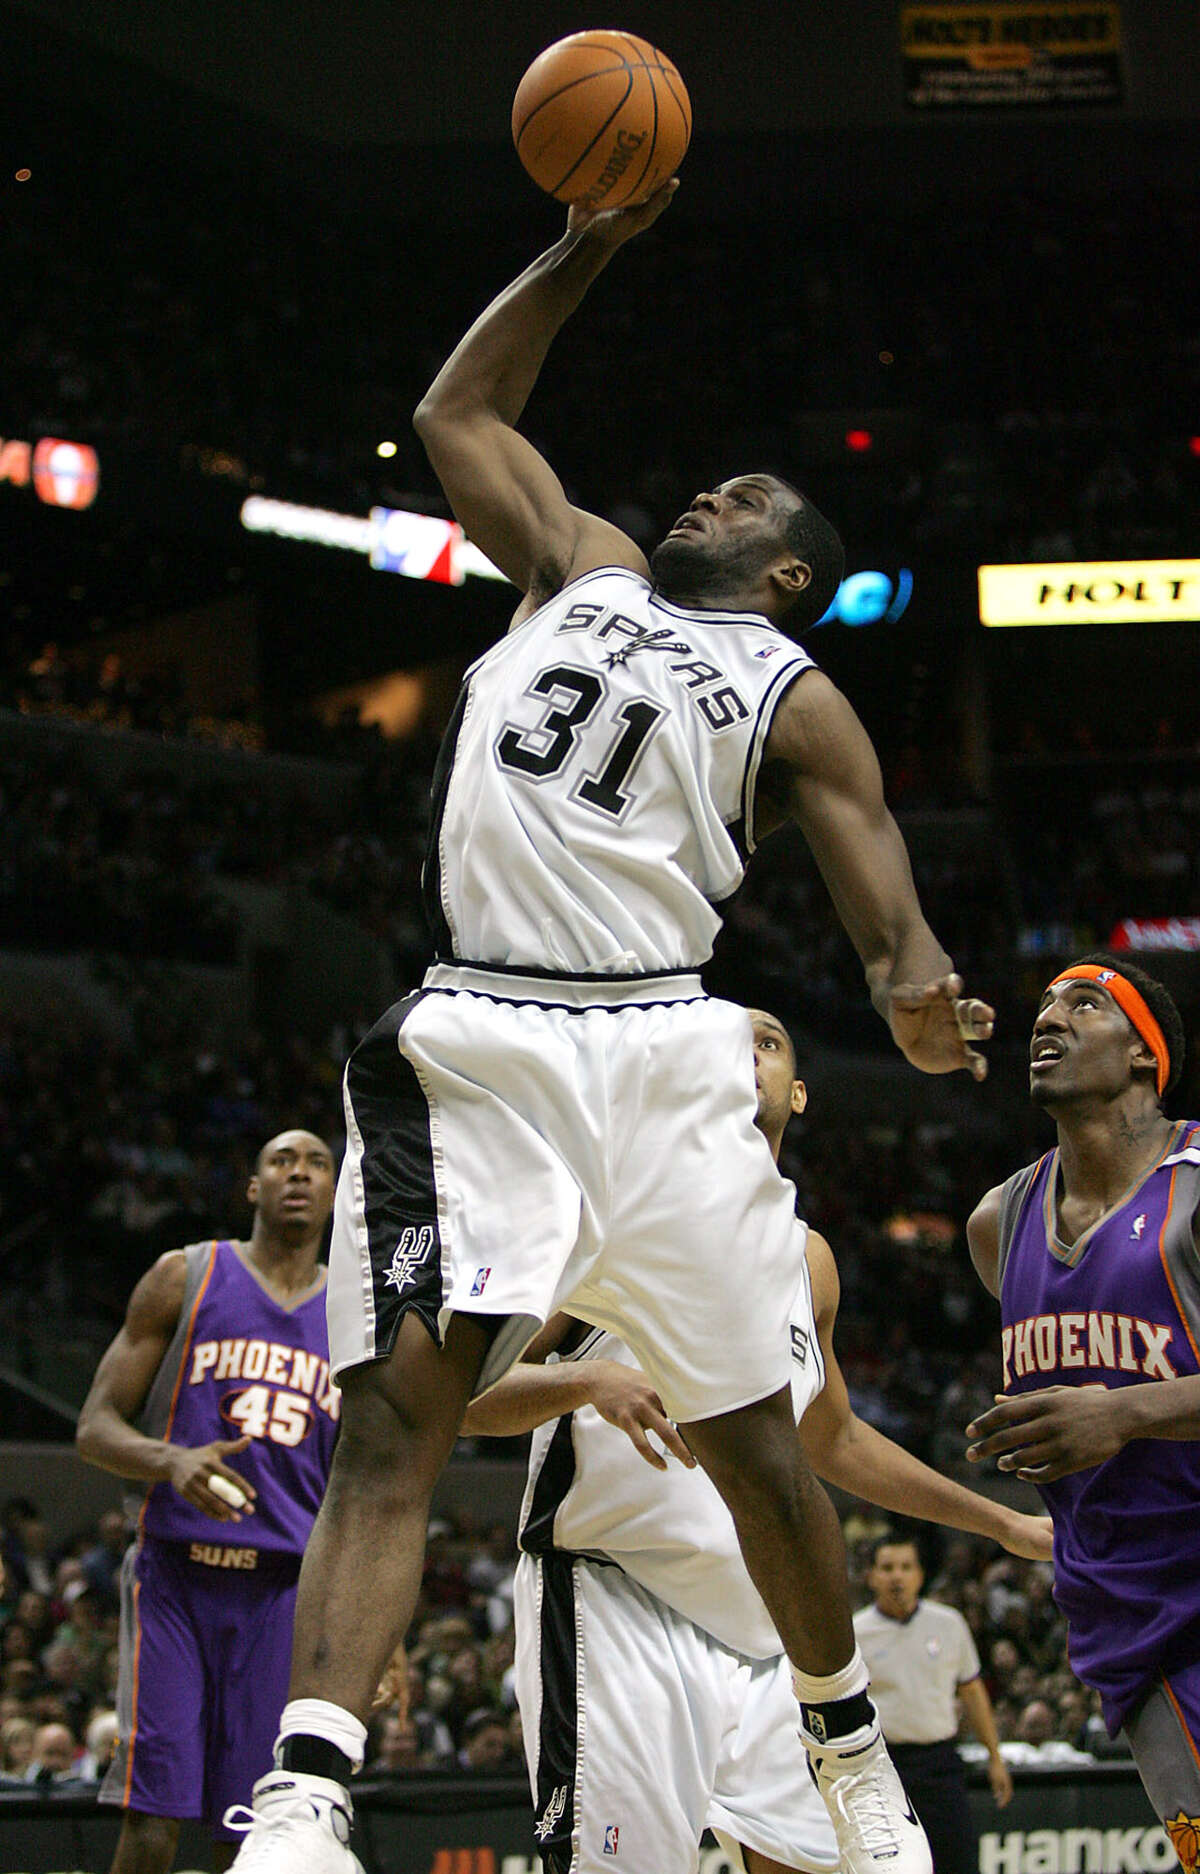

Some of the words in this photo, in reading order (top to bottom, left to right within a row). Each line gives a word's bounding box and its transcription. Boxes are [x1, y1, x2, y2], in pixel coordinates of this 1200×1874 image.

[1039, 580, 1184, 604] HOLT
[554, 603, 752, 734] SPURS
[493, 661, 672, 827] 31
[1001, 1310, 1178, 1391] PHOENIX
[229, 1384, 312, 1447] 45
[189, 1542, 258, 1570] SUNS
